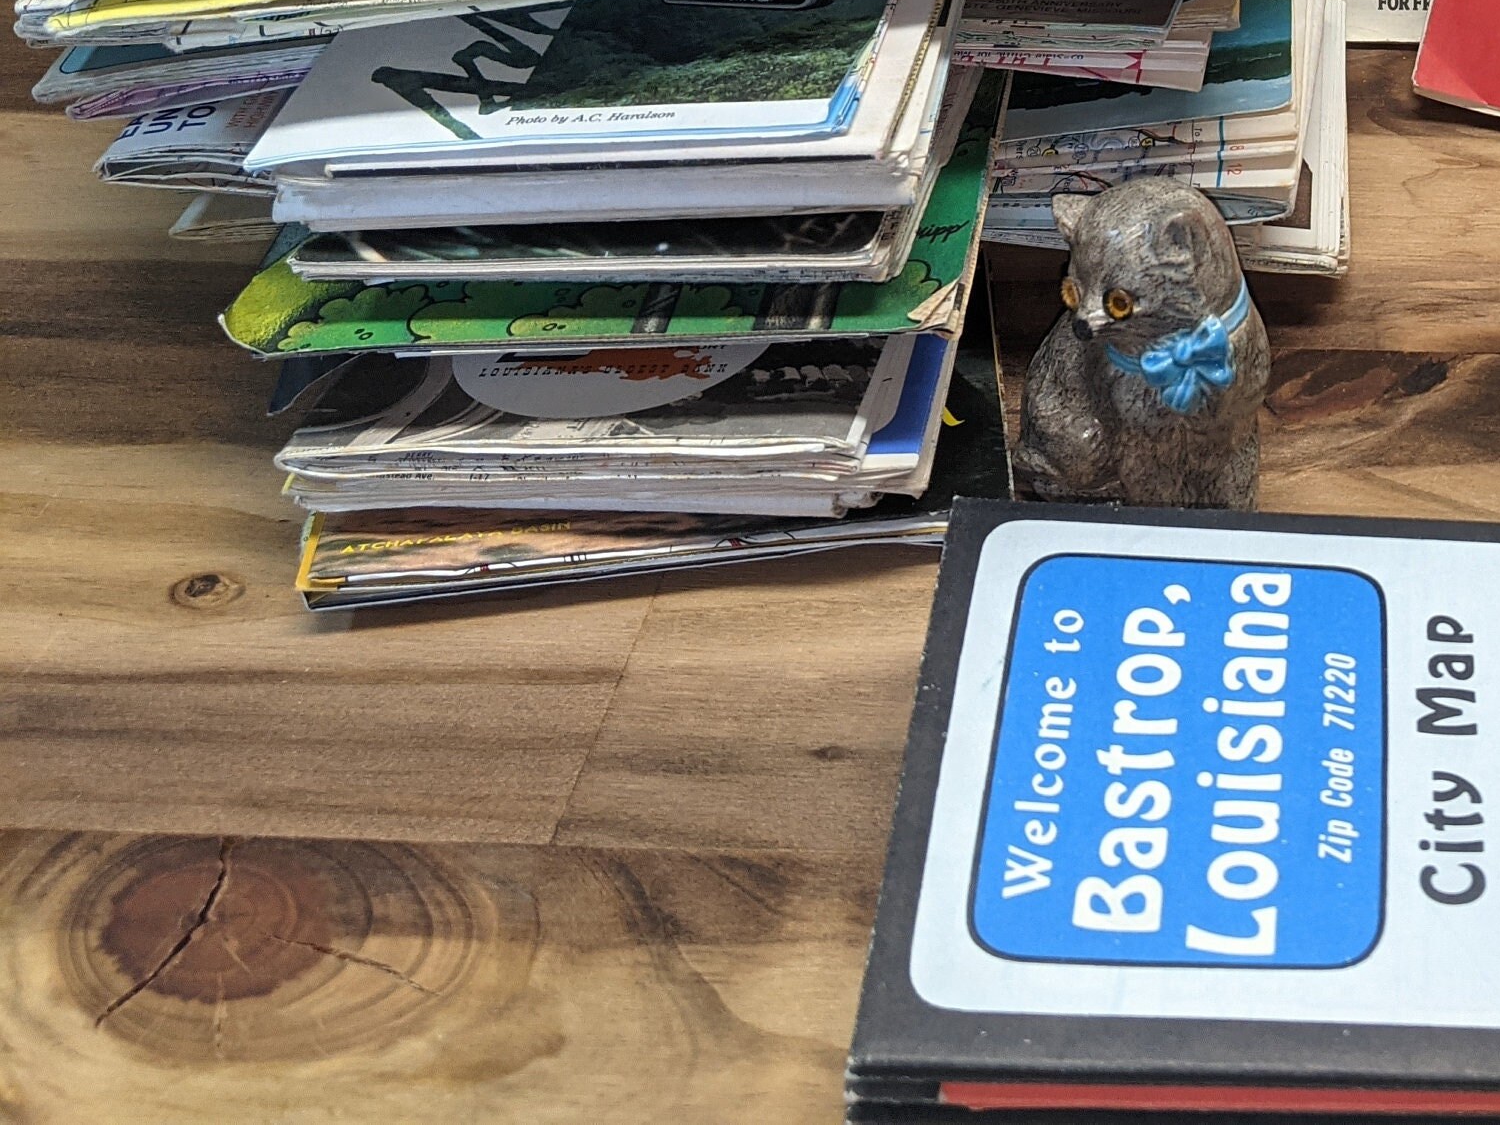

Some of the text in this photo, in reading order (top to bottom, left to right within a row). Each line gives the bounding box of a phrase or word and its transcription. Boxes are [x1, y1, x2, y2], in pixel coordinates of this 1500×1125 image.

[505, 110, 676, 126] Photo by A.C. Haralson
[478, 363, 729, 377] LOUISIANA'S OLDEST BANK
[340, 522, 571, 555] ATCHAFALAYA BASIN
[1002, 606, 1085, 900] Welcome to
[1072, 582, 1193, 933] Bastrop,
[1184, 570, 1292, 957] Louisiana
[1317, 652, 1360, 863] Zip Code 71220
[1415, 613, 1487, 907] City Map
